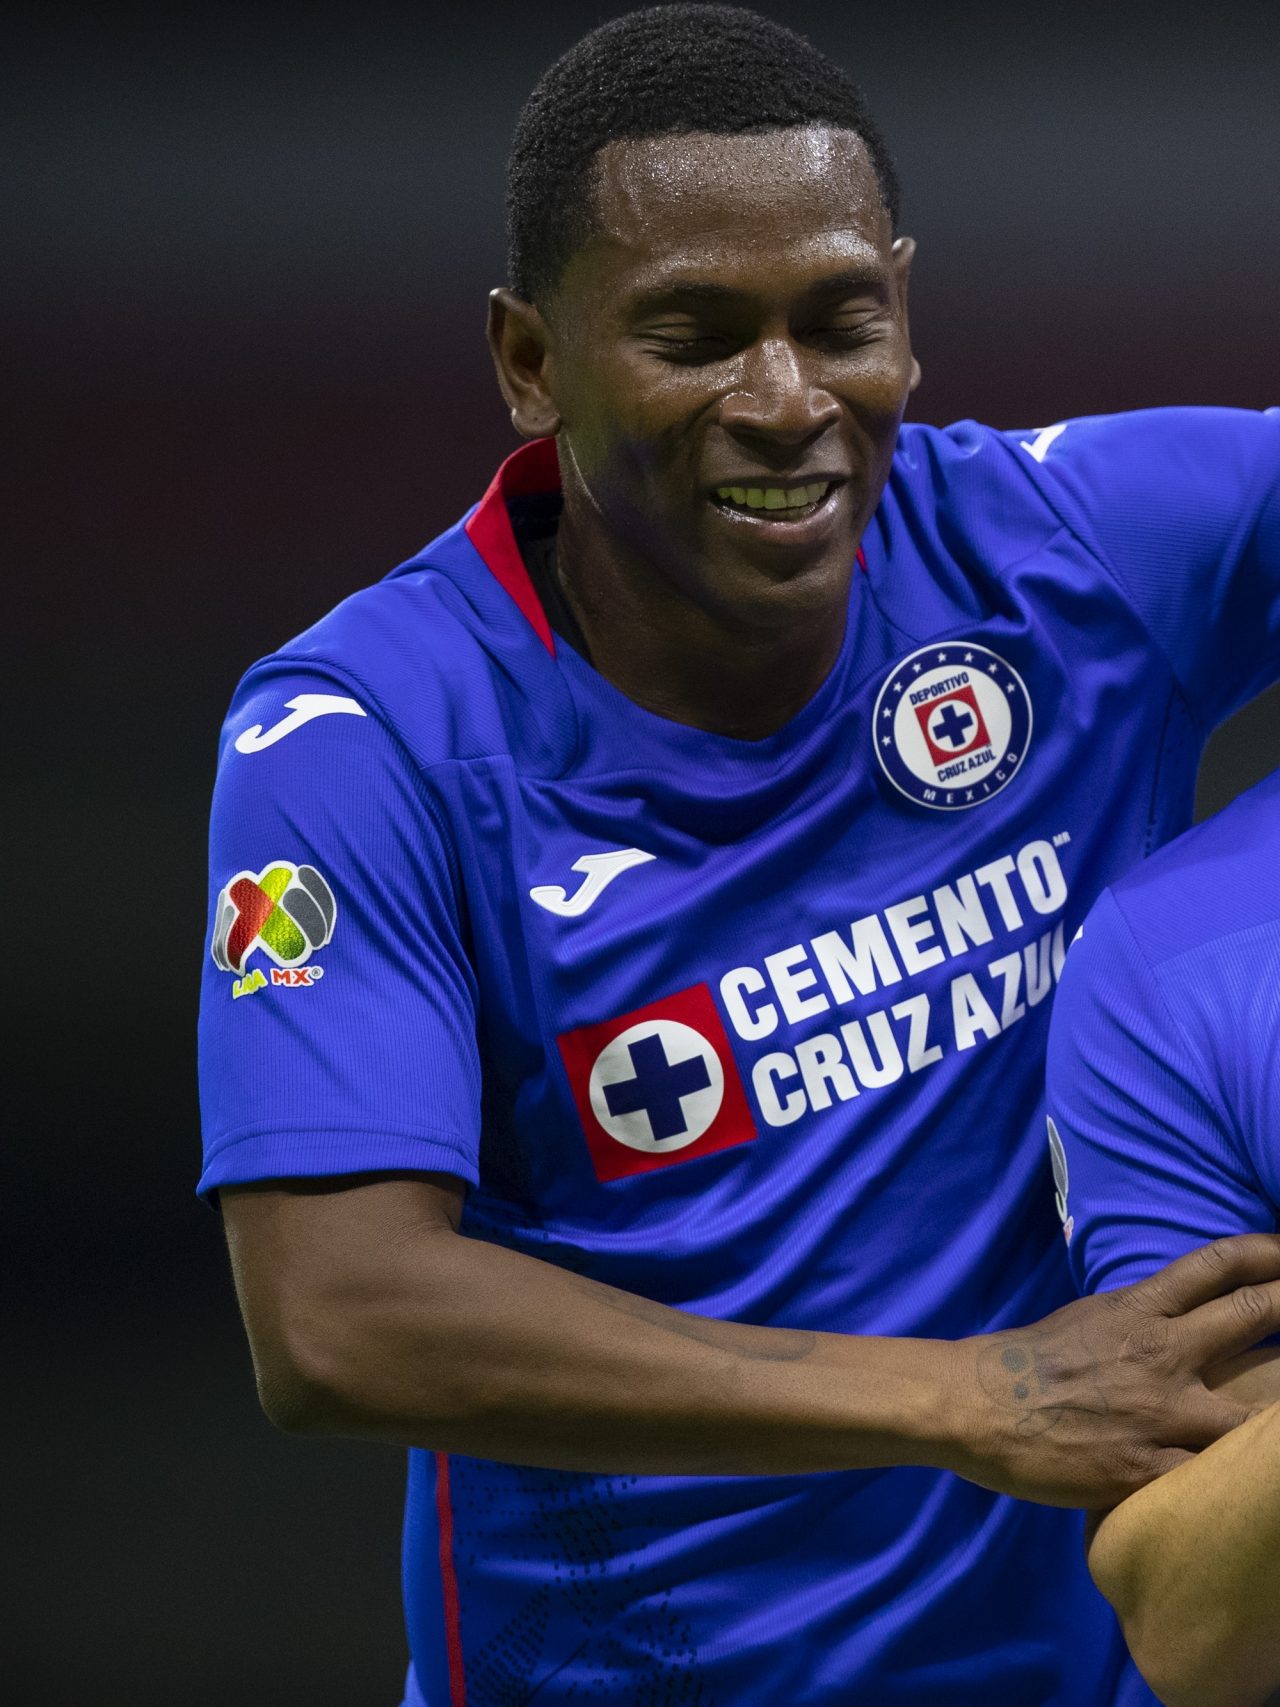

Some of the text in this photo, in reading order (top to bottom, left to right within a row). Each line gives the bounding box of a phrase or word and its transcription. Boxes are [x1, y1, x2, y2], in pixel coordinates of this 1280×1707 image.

[909, 672, 970, 706] DEPORTIVO
[923, 752, 1018, 804] MEXICO
[937, 749, 996, 782] CRUZ AZUL
[720, 839, 1068, 1042] CEMENTO
[751, 993, 943, 1127] CRUZ
